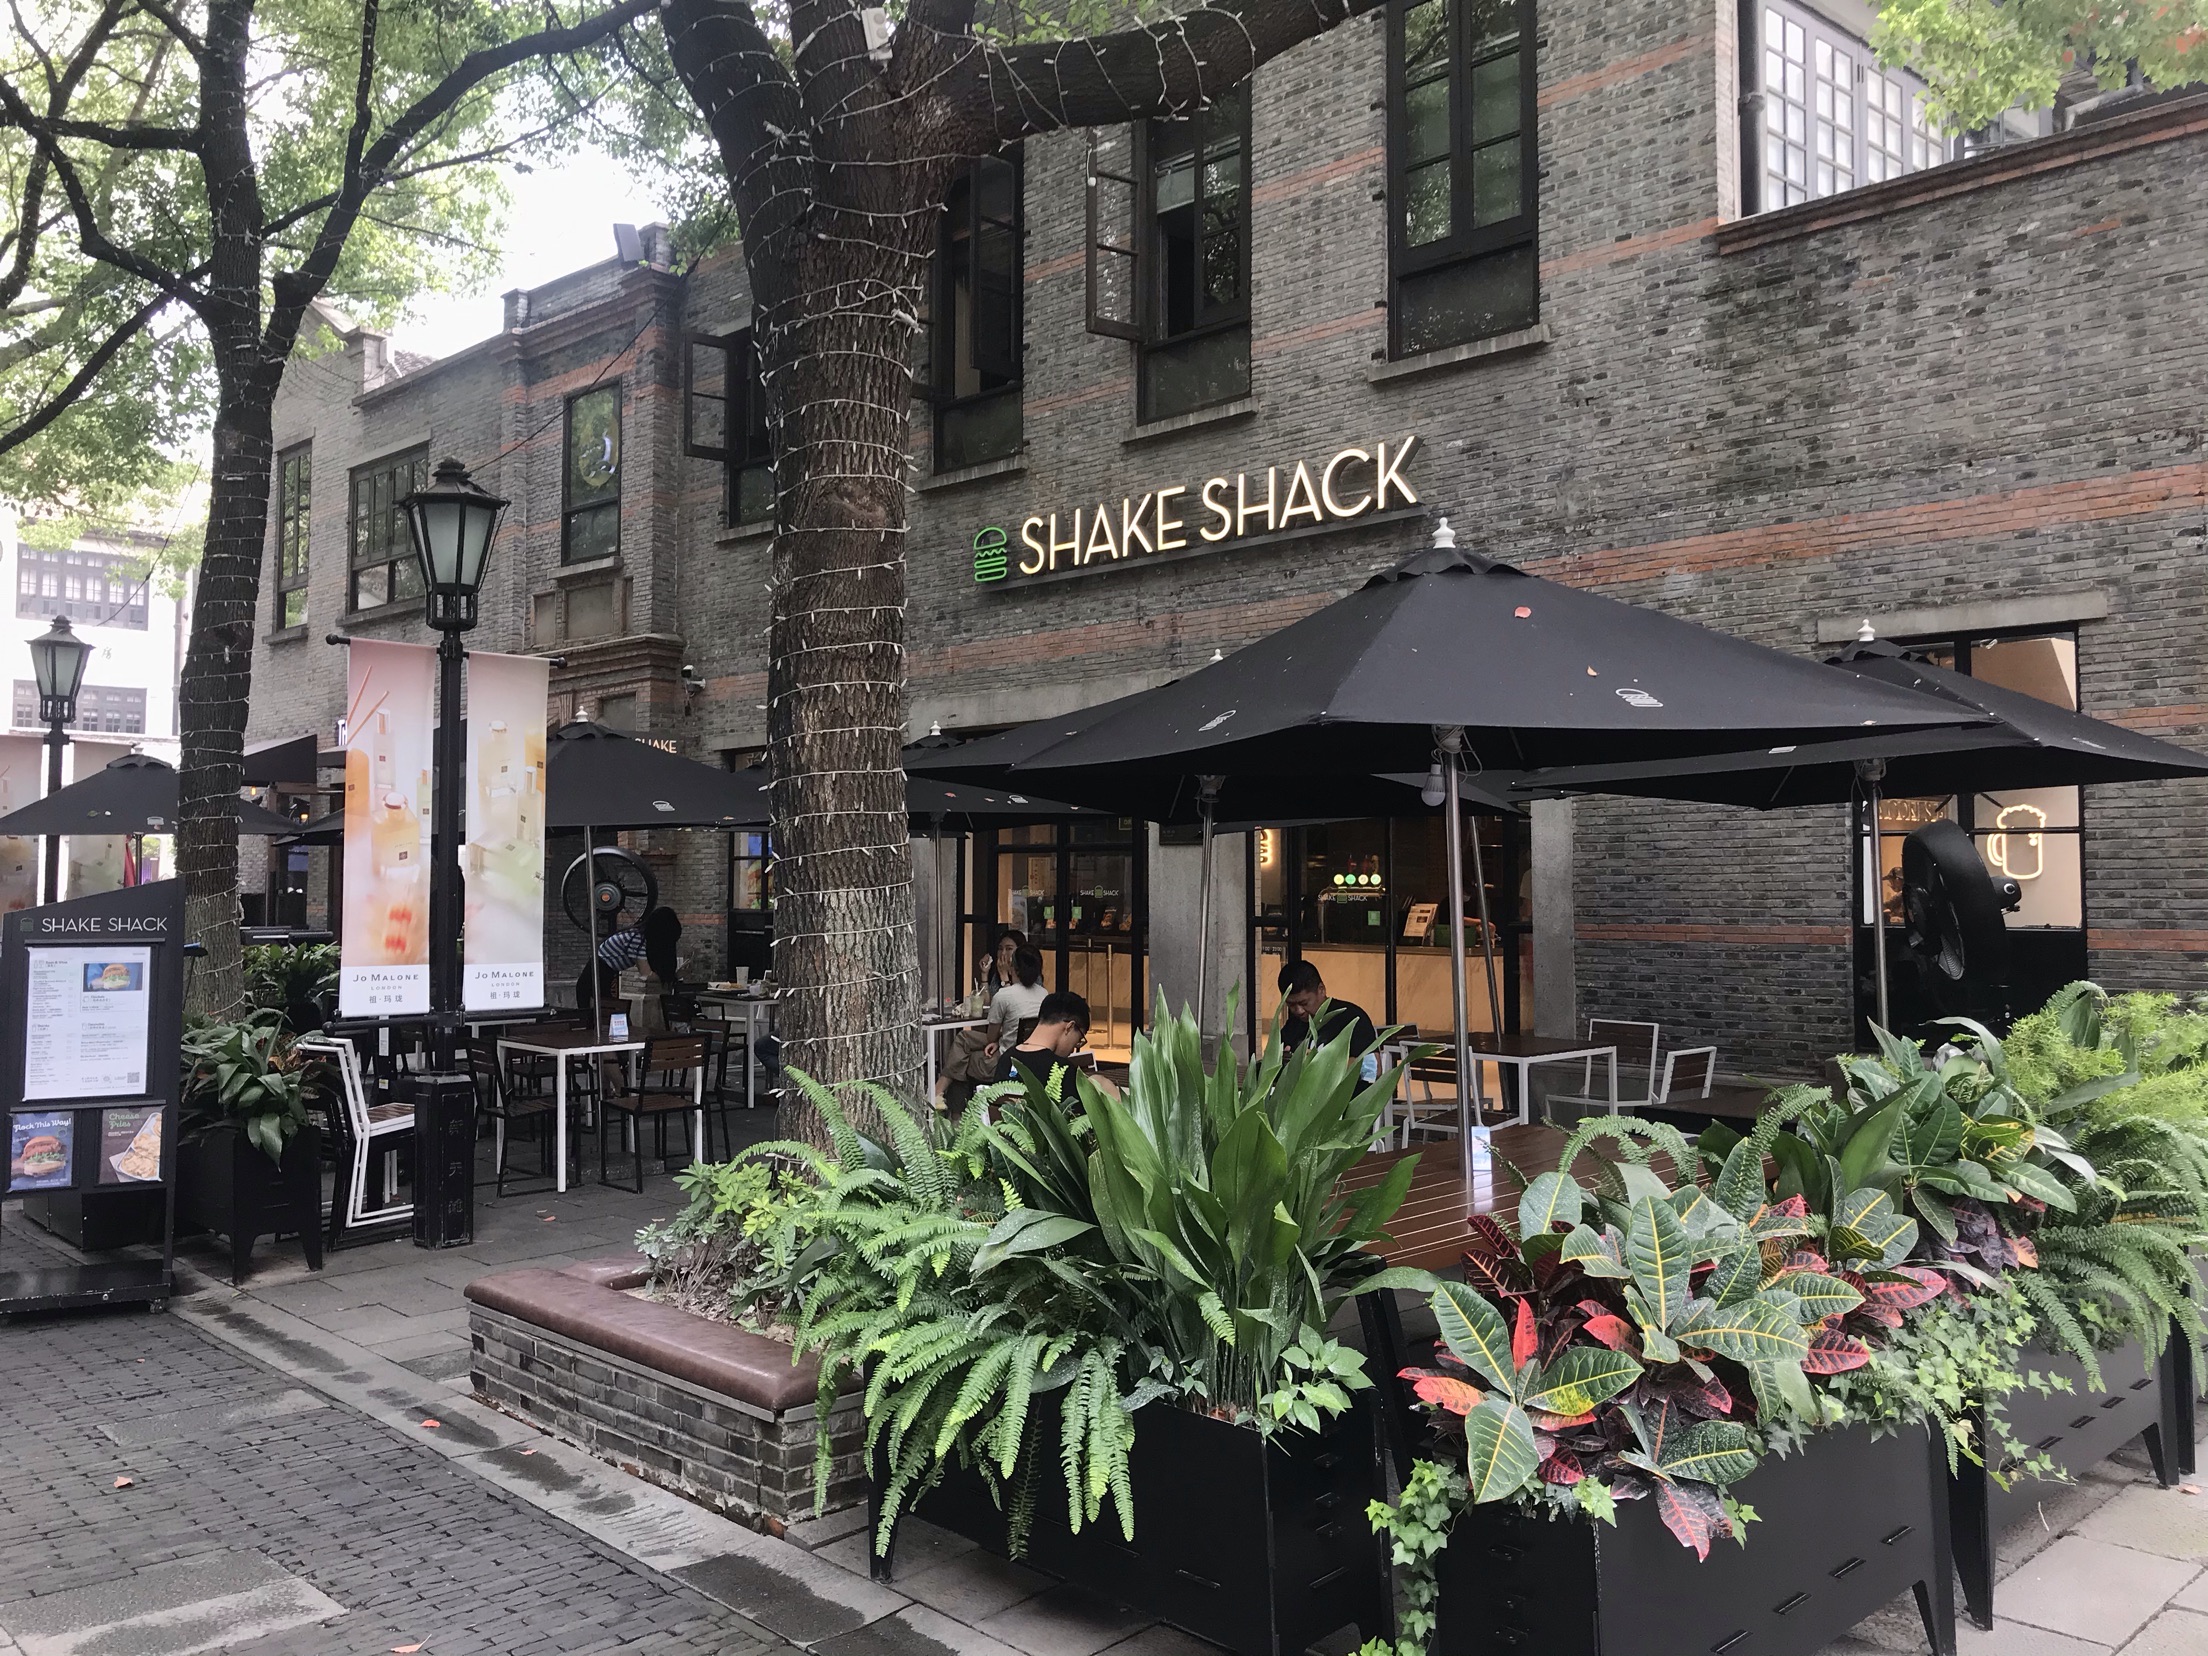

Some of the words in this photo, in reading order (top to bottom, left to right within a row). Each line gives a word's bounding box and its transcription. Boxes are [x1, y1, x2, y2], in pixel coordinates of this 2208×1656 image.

[1019, 485, 1187, 575] SHAKE
[1199, 435, 1421, 542] SHACK
[41, 917, 102, 933] SHAKE
[108, 916, 168, 932] SHACK
[370, 973, 419, 982] MALONE
[491, 970, 535, 979] MALONE
[108, 1112, 141, 1121] Cheese
[35, 1120, 51, 1130] This
[51, 1117, 72, 1130] Way!
[108, 1120, 132, 1129] Fries
